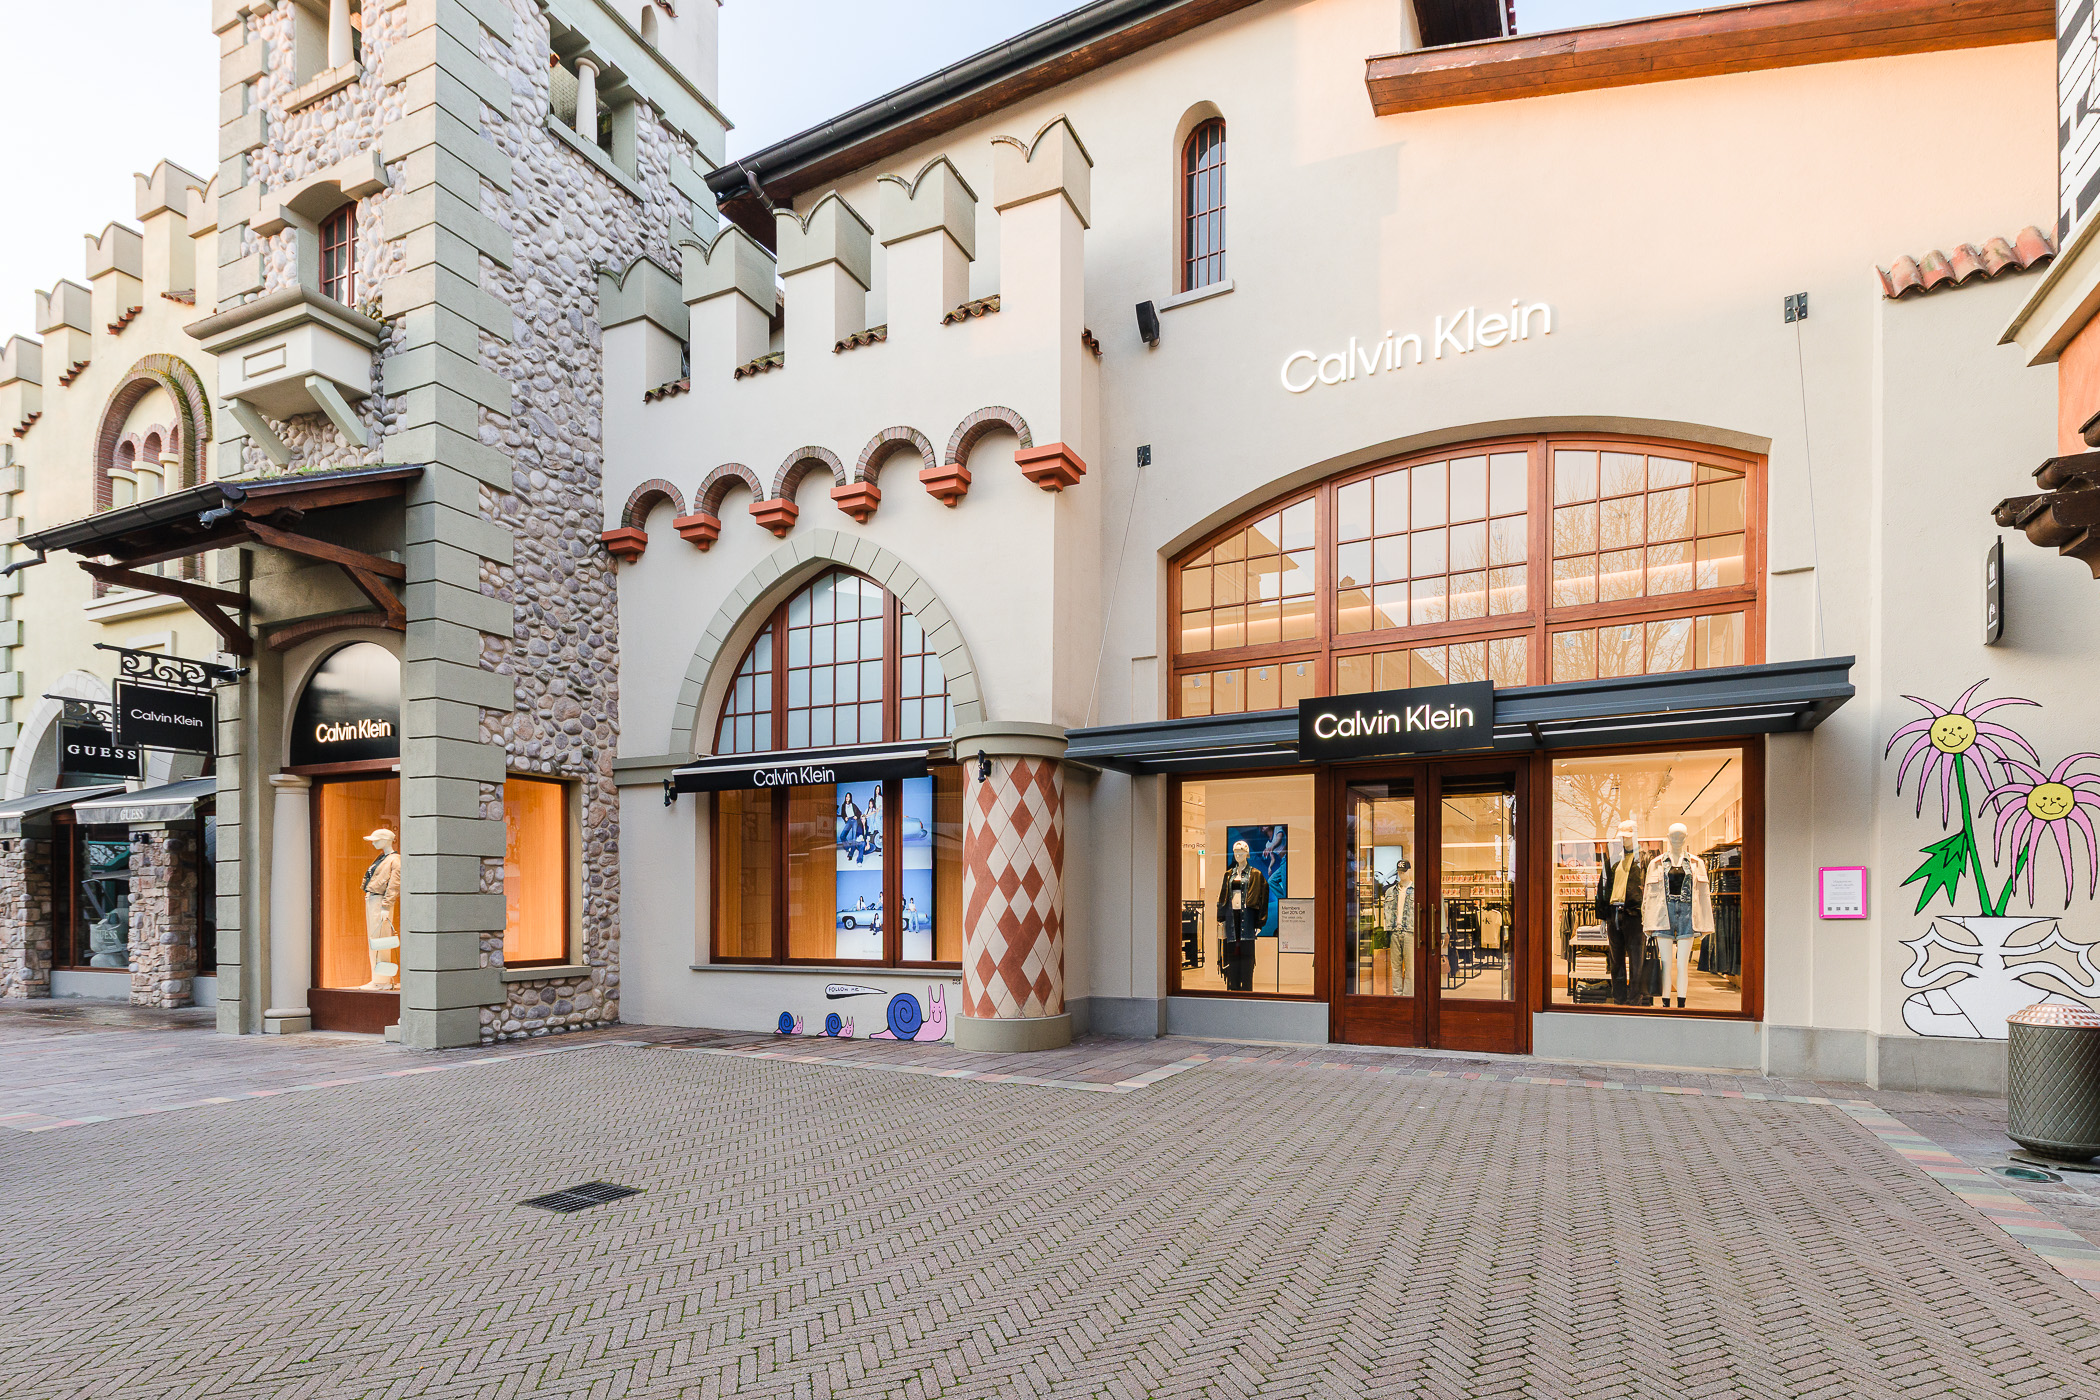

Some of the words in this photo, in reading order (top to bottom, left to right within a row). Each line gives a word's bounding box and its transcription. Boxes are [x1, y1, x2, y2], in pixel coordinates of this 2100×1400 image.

[1280, 329, 1422, 393] Calvin
[1434, 298, 1551, 360] Klein
[130, 708, 172, 723] Calvin
[174, 714, 203, 727] Klein
[1314, 709, 1400, 739] Calvin
[1406, 703, 1474, 732] Klein
[316, 722, 357, 743] Calvin
[359, 718, 391, 739] Klein
[67, 744, 137, 760] GUESS
[753, 768, 798, 787] Calvin
[800, 766, 835, 784] Klein
[120, 808, 144, 820] GUESS
